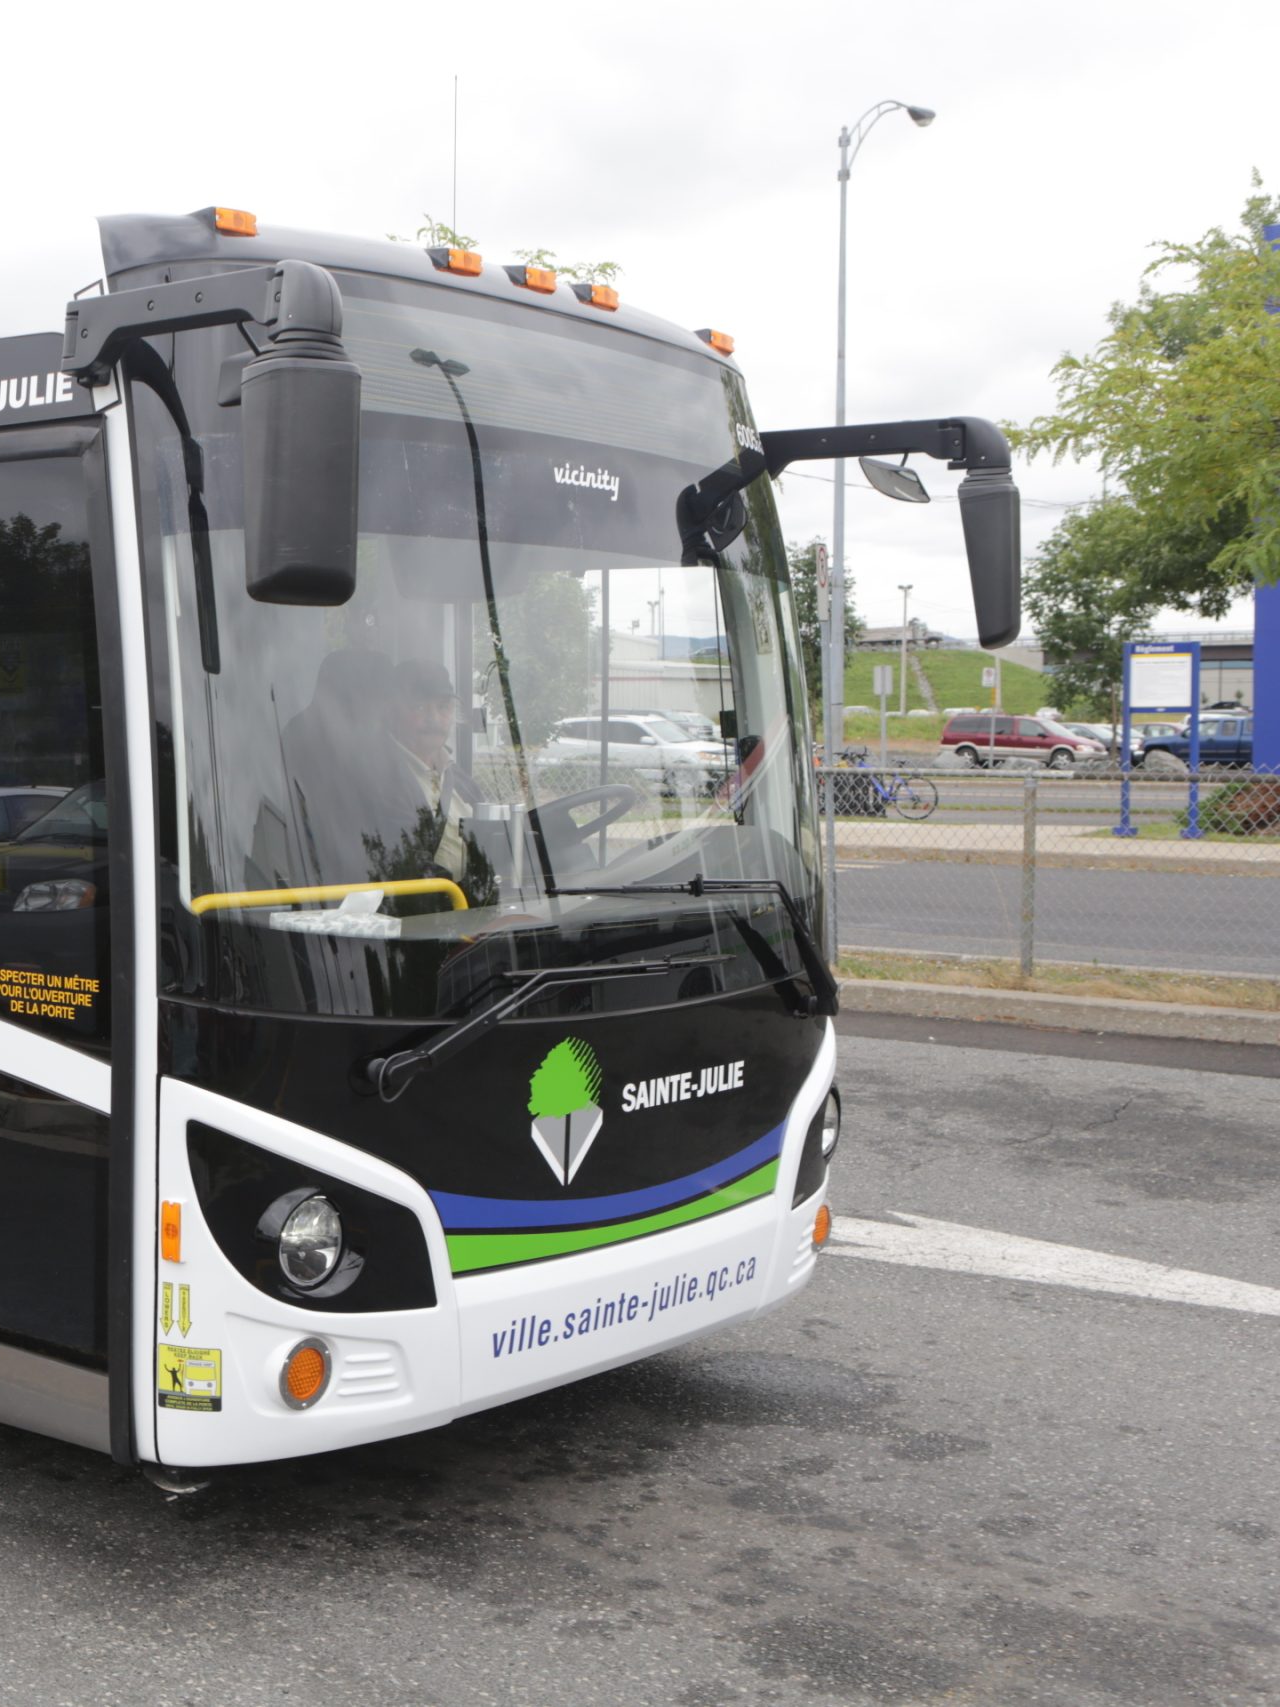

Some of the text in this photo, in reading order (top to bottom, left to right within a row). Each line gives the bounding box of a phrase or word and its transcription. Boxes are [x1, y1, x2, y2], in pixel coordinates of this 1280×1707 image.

[554, 462, 620, 501] vicinity
[47, 974, 62, 988] UN
[10, 1000, 76, 1020] DE LA PORTE
[23, 987, 92, 1007] L'OUVERTURE
[621, 1060, 745, 1113] SAINTE-JULIE
[492, 1256, 756, 1358] ville.sainte-julie.qc.ca
